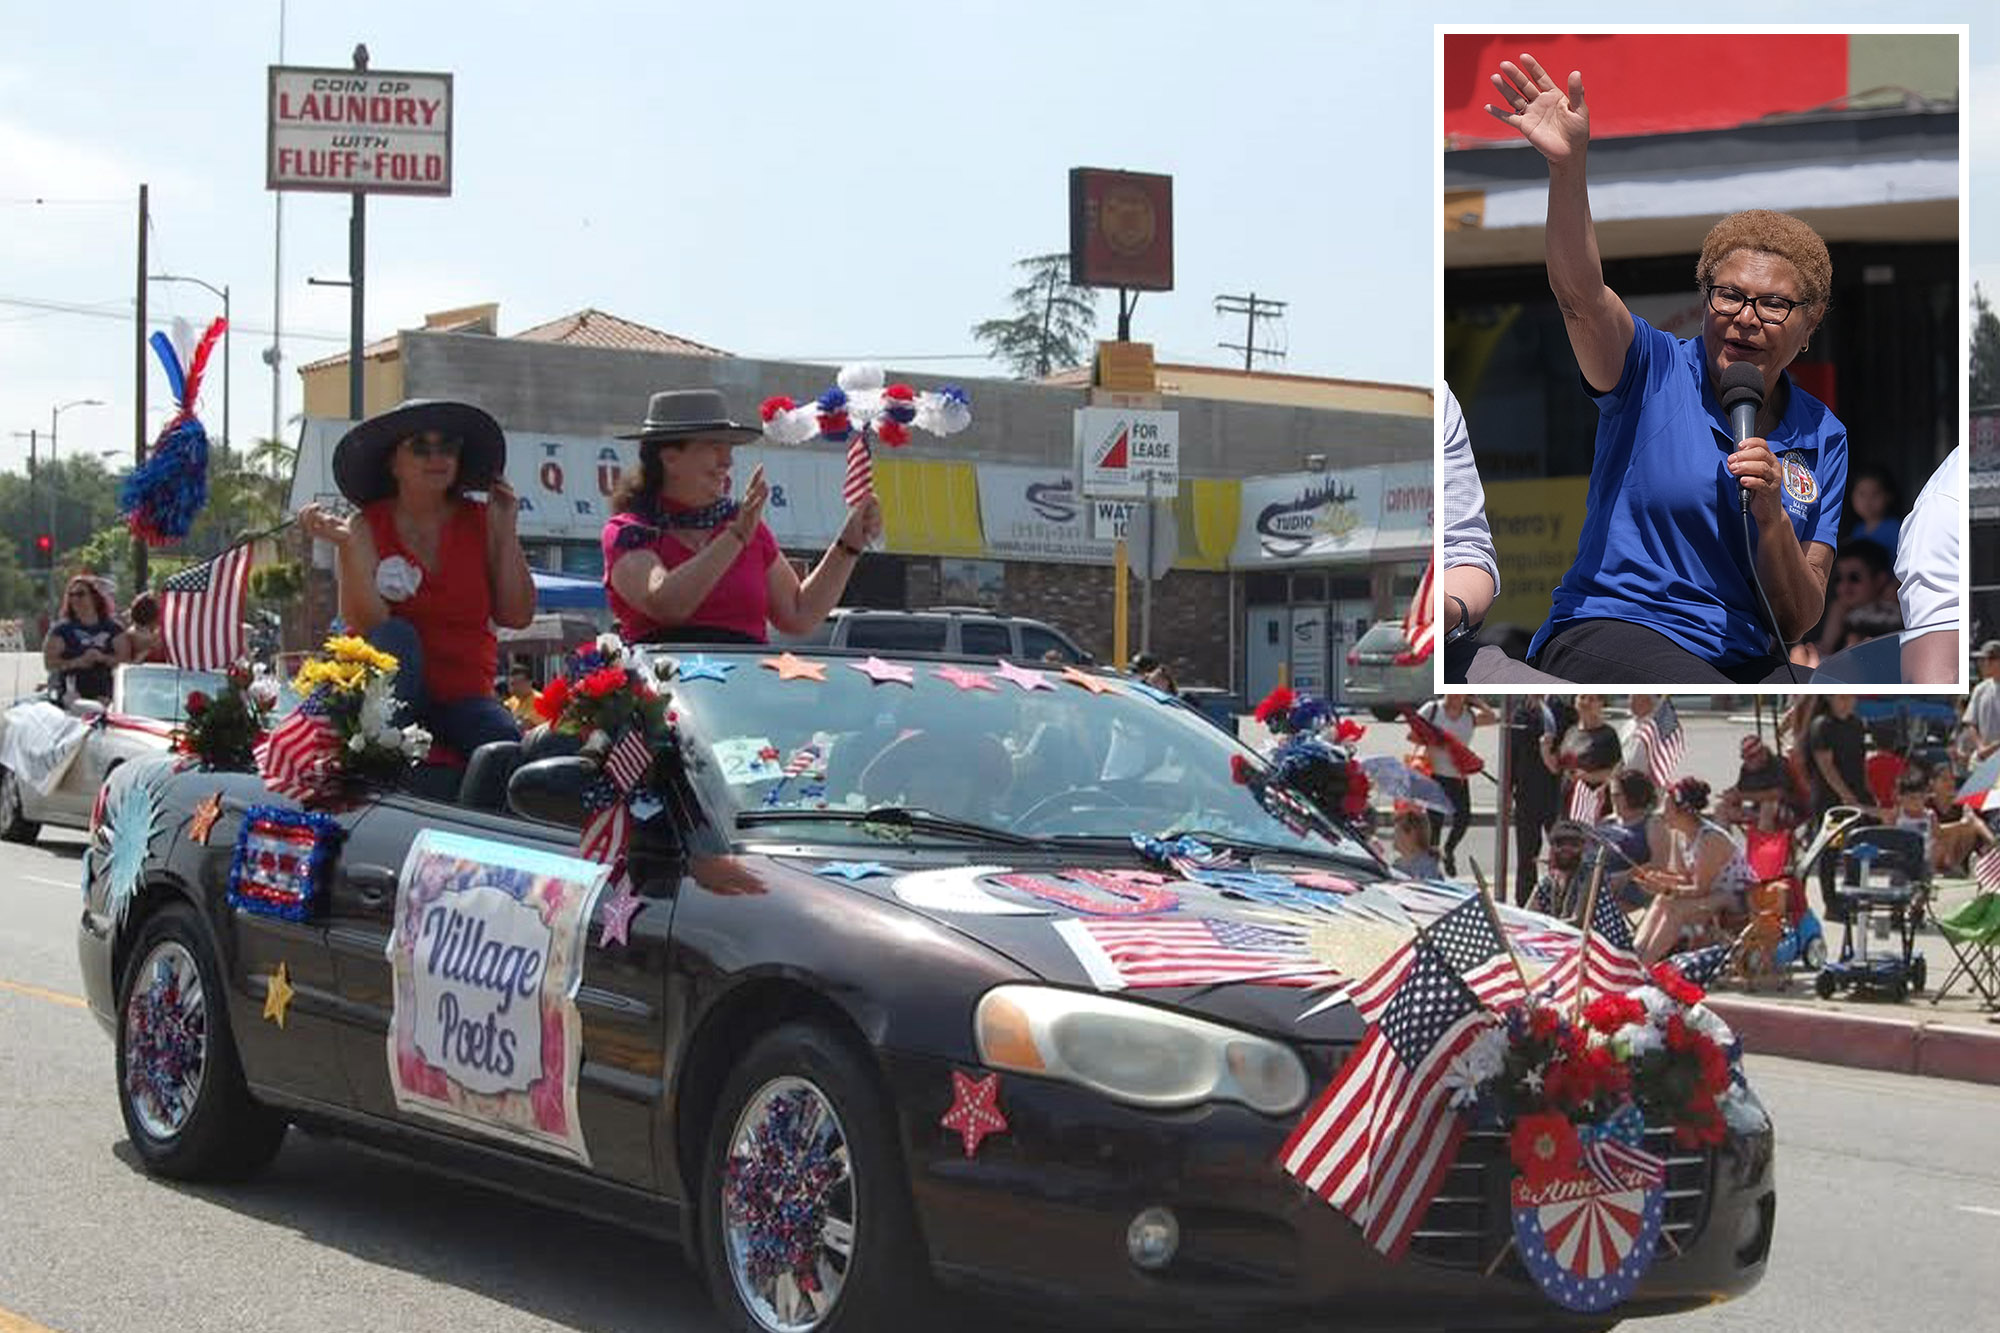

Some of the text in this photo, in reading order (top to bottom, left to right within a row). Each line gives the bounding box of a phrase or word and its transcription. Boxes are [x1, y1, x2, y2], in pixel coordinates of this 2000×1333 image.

[312, 78, 410, 95] COIN OP
[279, 93, 440, 126] LAUNDRY
[331, 135, 389, 149] WITH
[1132, 423, 1158, 439] FOR
[1132, 442, 1171, 459] LEASE
[424, 906, 541, 1014] Village
[438, 991, 517, 1077] Poets
